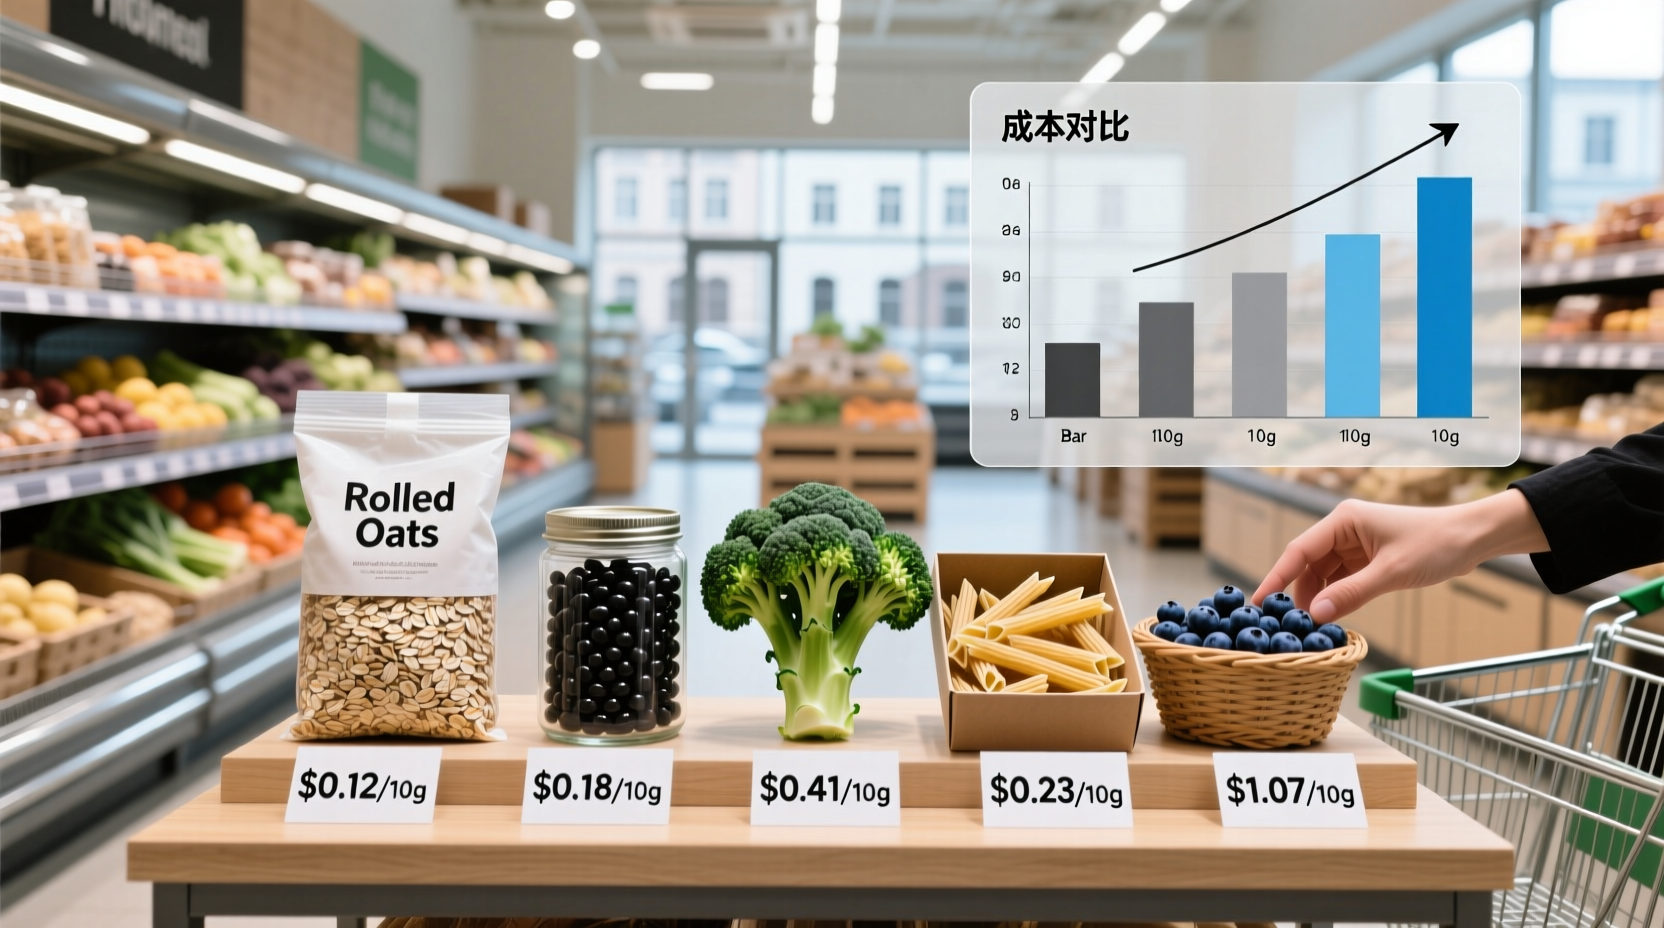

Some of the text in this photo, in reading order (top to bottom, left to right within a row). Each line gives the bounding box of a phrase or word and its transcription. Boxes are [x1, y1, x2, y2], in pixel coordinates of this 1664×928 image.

[344, 481, 456, 513] Rolled
[355, 517, 439, 549] Oats
[297, 767, 427, 805] $0.12/10g
[532, 769, 662, 806] $0.18/10g
[759, 770, 891, 808] $0.41/10g
[990, 771, 1123, 809] $0.23/10g
[1226, 772, 1356, 809] $1.07/10g
